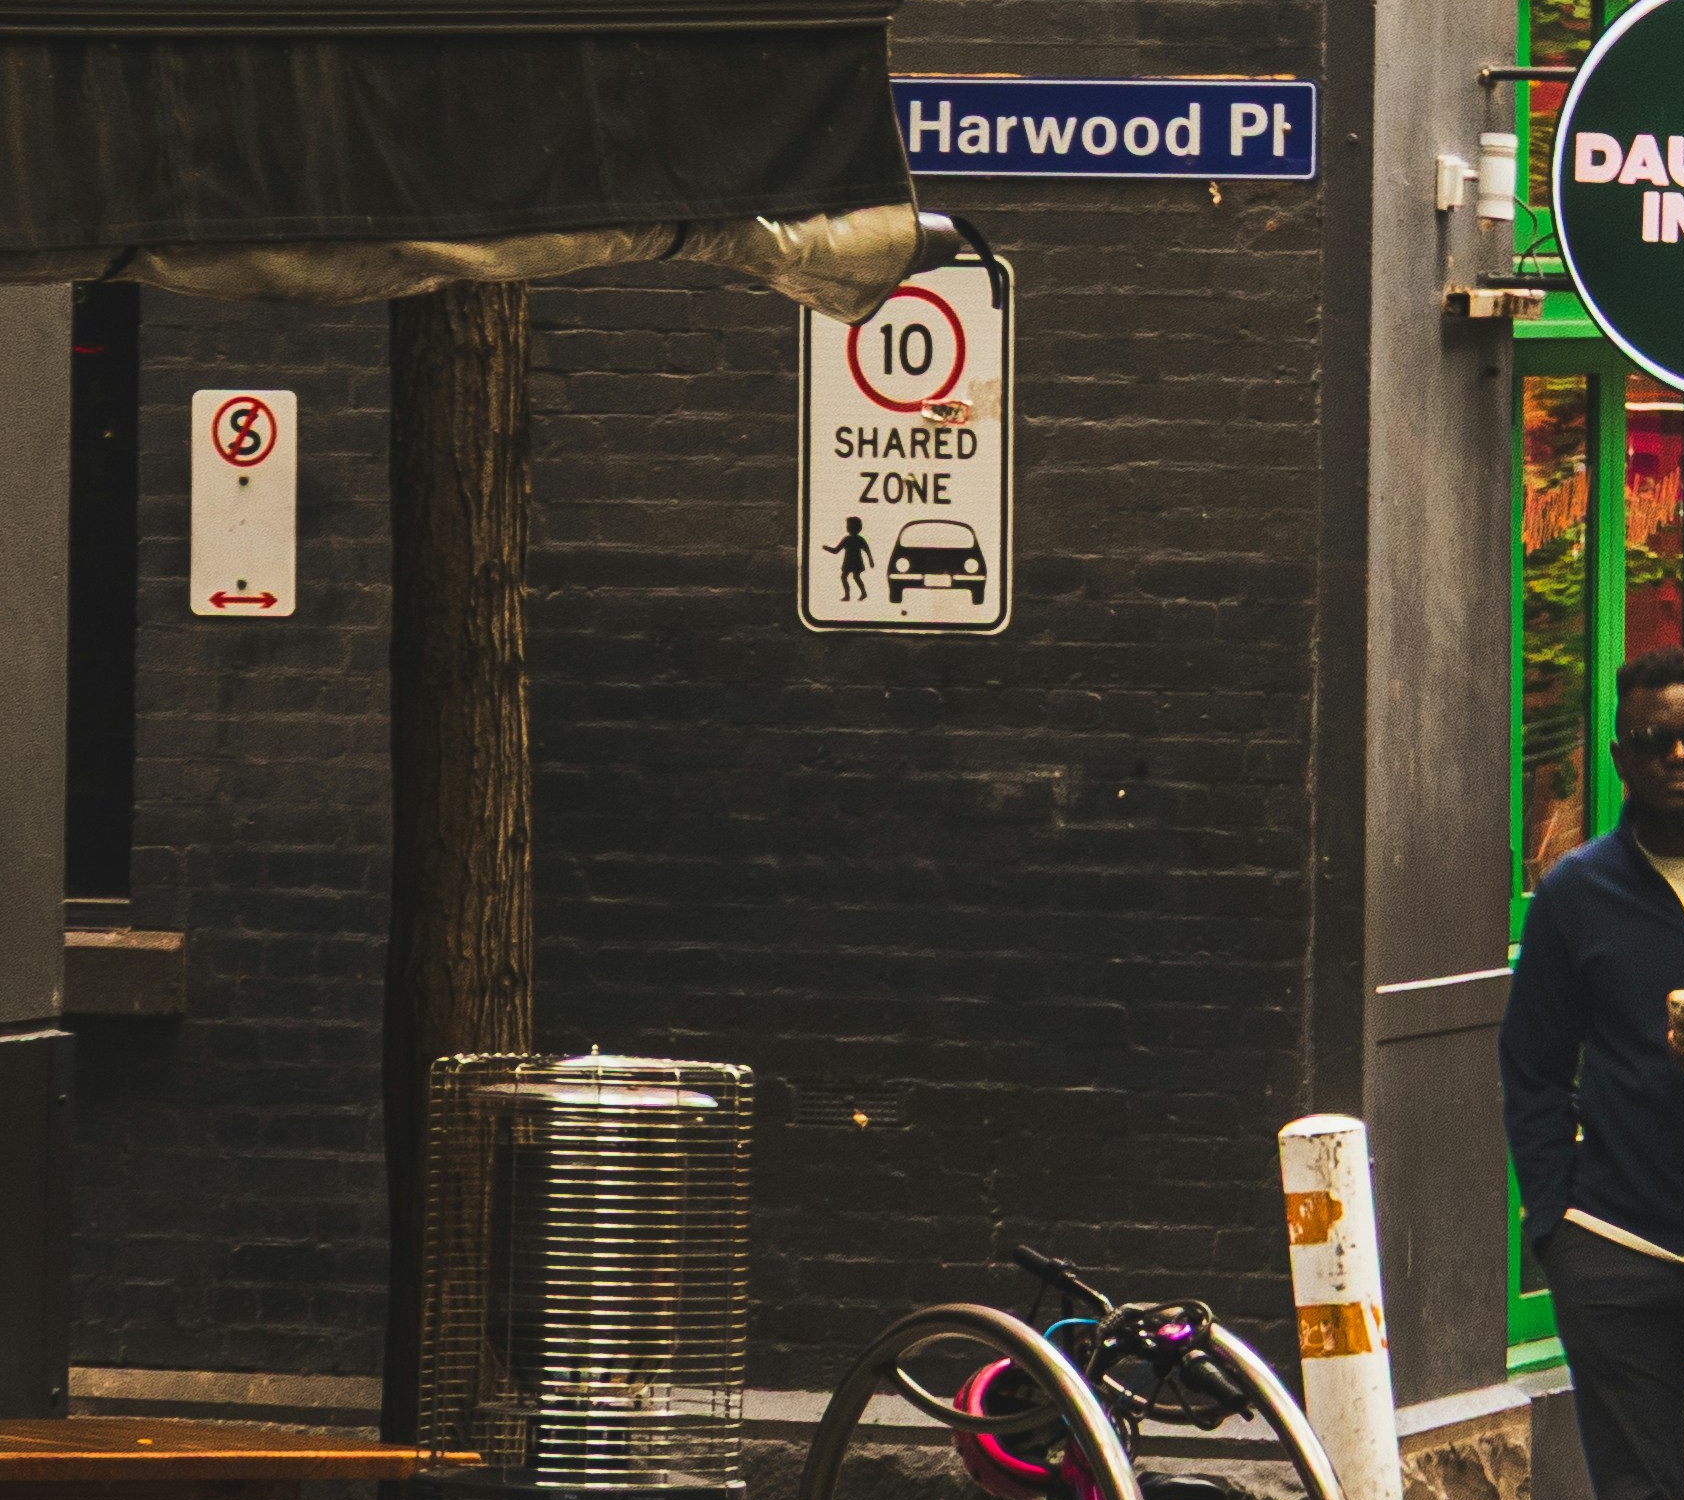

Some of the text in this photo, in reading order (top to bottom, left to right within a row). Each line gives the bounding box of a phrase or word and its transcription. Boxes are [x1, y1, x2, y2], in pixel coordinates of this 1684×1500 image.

[909, 100, 1285, 157] Harwood Pl
[880, 323, 933, 376] 10
[834, 426, 978, 460] SHARED
[858, 471, 952, 505] ZONE
